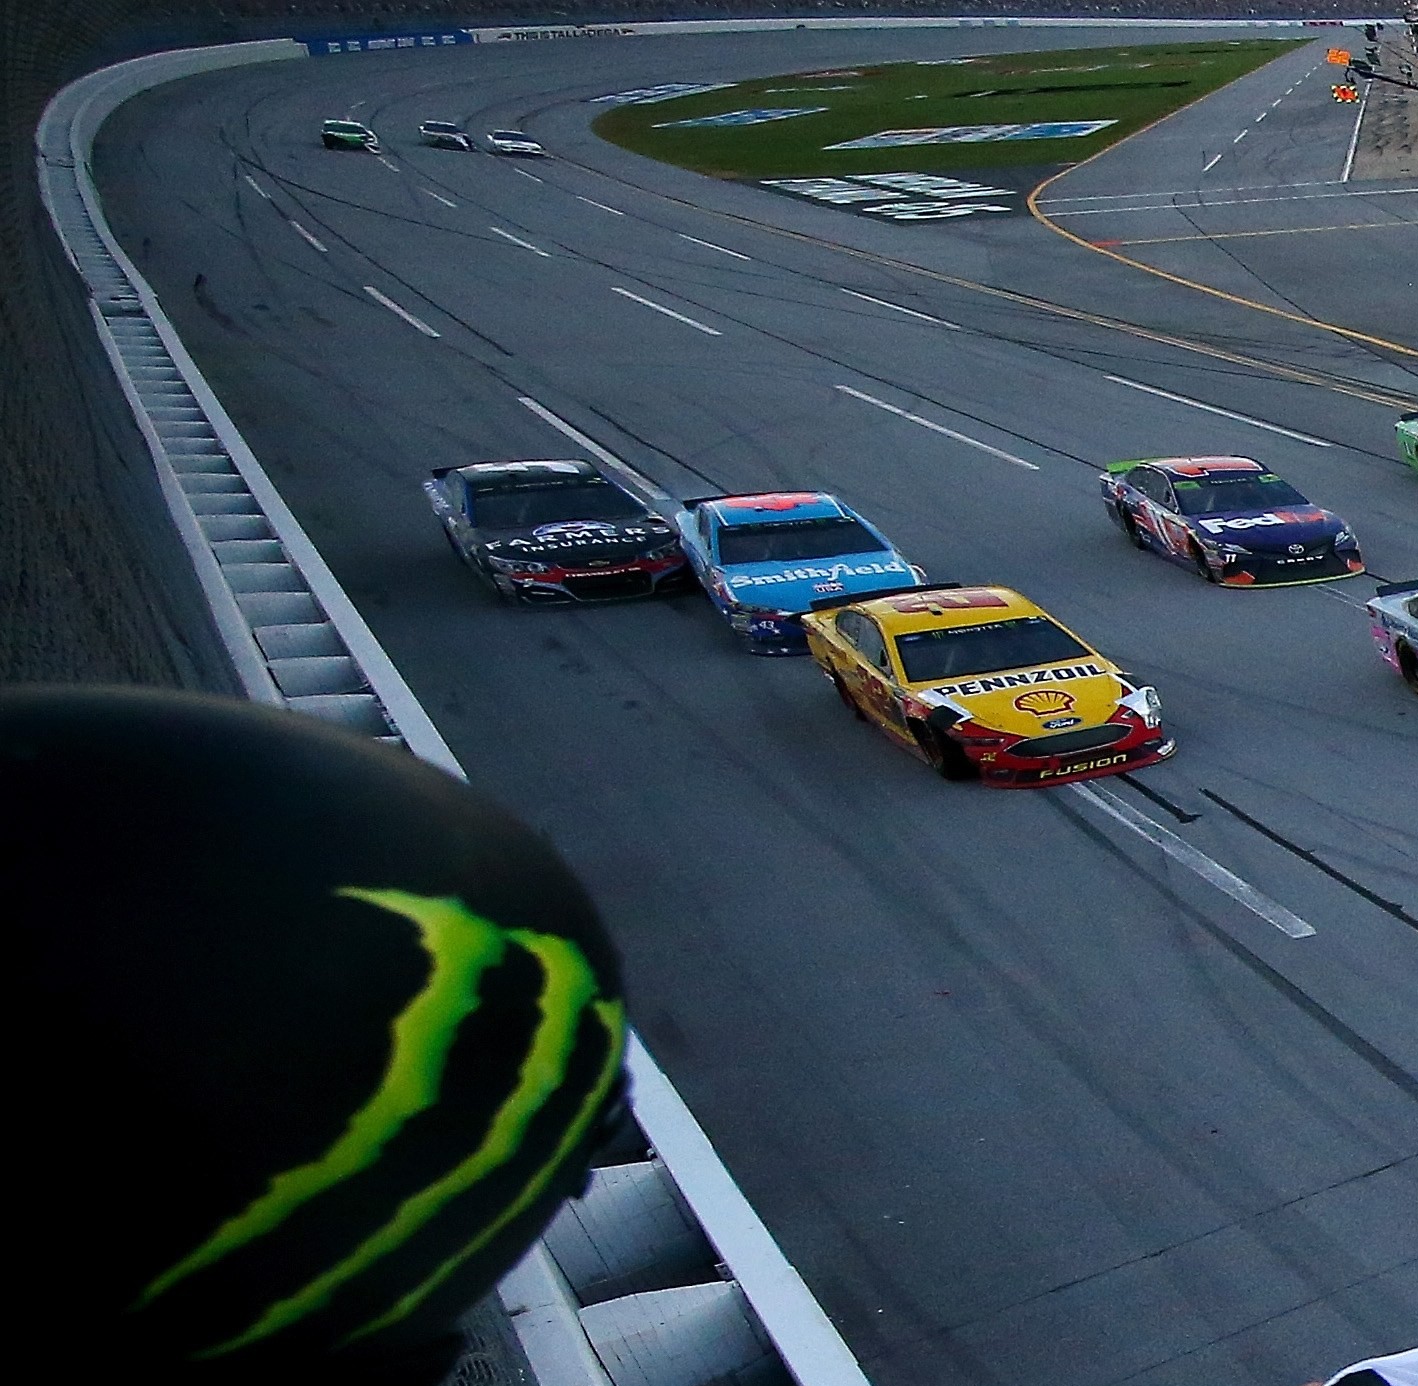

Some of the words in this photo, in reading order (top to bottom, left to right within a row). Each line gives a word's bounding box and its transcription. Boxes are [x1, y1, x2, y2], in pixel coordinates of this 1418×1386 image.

[485, 525, 672, 551] FARMERS
[522, 536, 648, 553] INSURANCE
[730, 560, 907, 589] Smithfield
[933, 663, 1107, 698] PENNZOIL
[1040, 753, 1128, 780] FUSION
